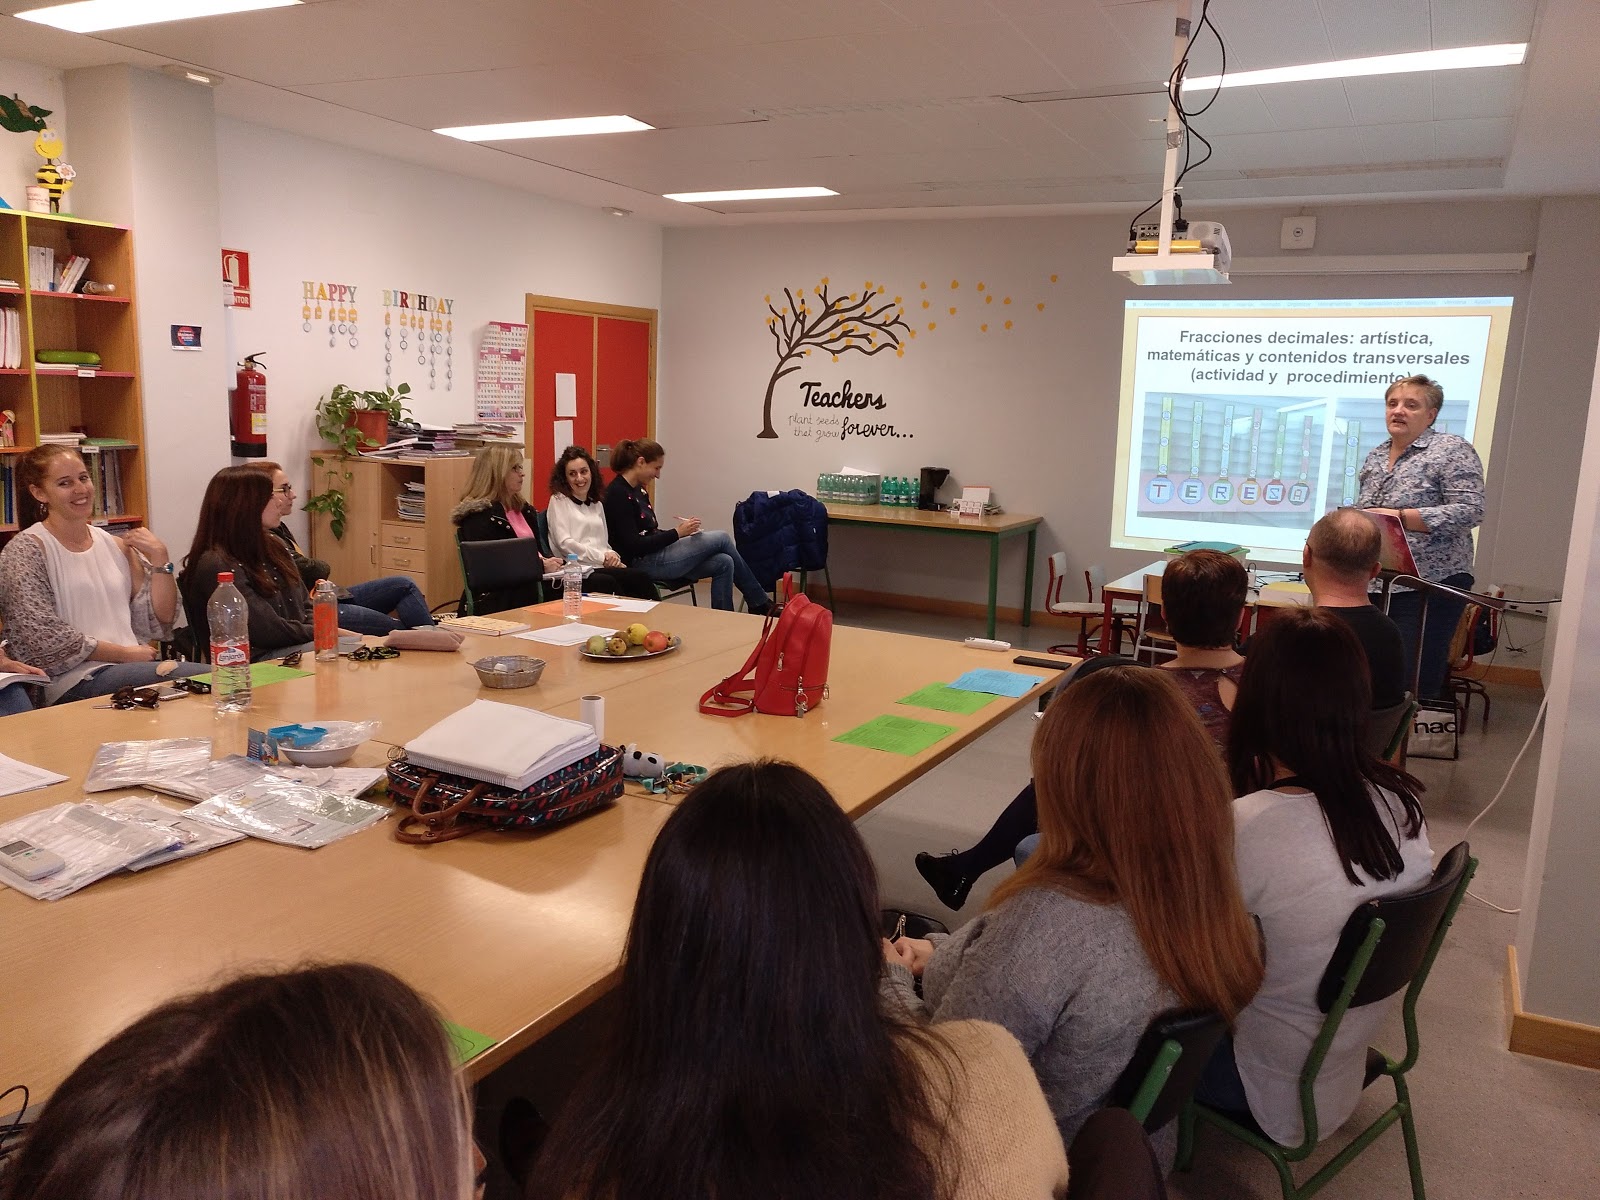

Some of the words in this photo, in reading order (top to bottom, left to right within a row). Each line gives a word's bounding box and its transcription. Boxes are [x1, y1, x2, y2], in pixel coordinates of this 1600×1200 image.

[302, 281, 357, 303] HAPPY
[382, 289, 454, 314] BIRTHDAY
[1179, 330, 1263, 344] Fracciones
[1267, 331, 1354, 345] decimales:
[1359, 331, 1433, 347] artística,
[1147, 349, 1241, 362] matemáticas
[1244, 352, 1255, 366] y
[1258, 351, 1347, 364] contenidos
[1352, 351, 1470, 365] transversales
[1190, 368, 1265, 383] (actividad
[1268, 372, 1279, 385] y
[800, 380, 887, 410] Teachers
[788, 412, 813, 426] plant
[816, 414, 840, 426] seeds
[793, 427, 812, 437] that
[815, 428, 840, 442] grow
[1414, 722, 1456, 734] nac
